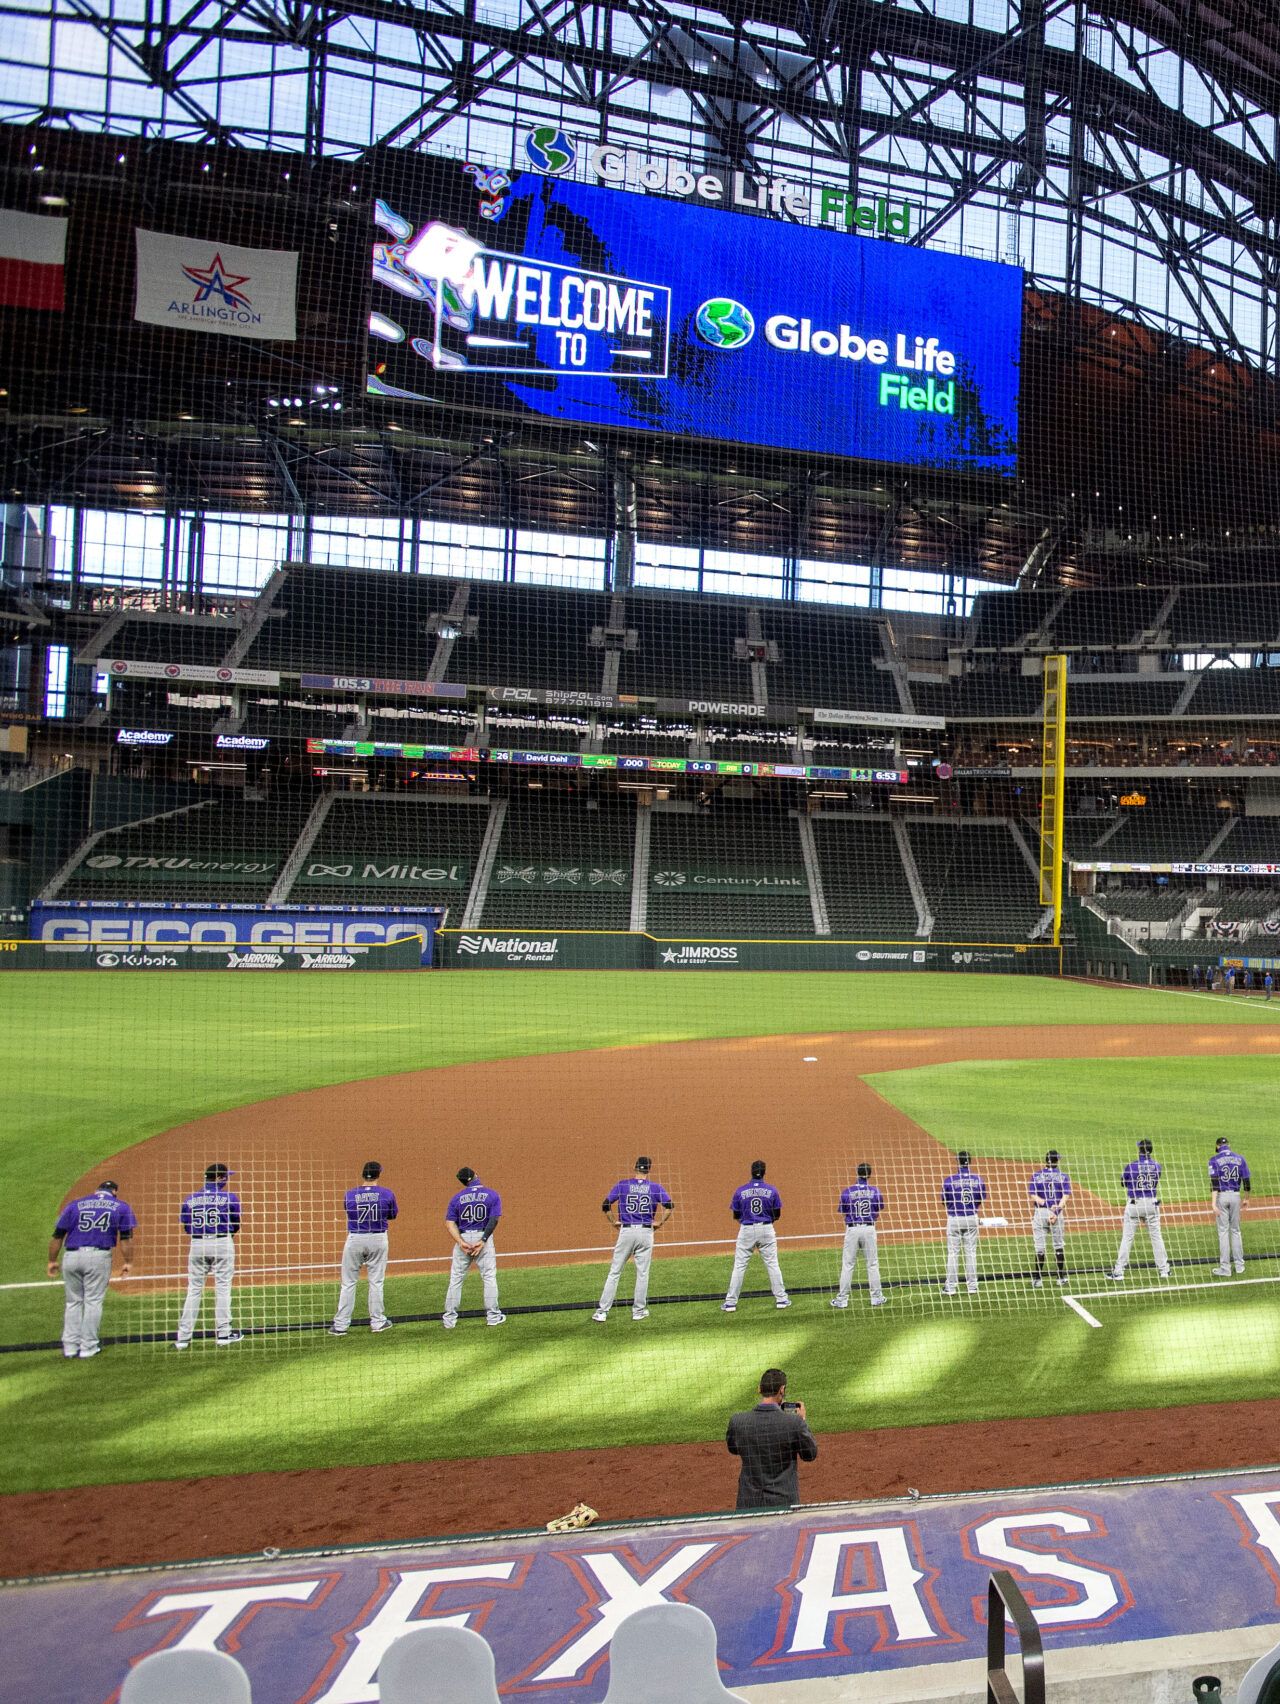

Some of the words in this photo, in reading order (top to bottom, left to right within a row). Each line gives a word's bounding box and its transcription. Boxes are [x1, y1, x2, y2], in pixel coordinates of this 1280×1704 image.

[591, 145, 723, 200] Globe
[735, 171, 810, 217] Life
[821, 190, 910, 237] Field
[473, 257, 655, 337] WELCOME
[168, 300, 261, 324] ARLINGTON
[555, 331, 587, 366] TO
[765, 315, 889, 364] Globe
[896, 333, 955, 375] Life
[879, 372, 955, 414] Field
[332, 677, 370, 690] 105.3
[373, 680, 401, 694] THE
[503, 687, 538, 700] PGL
[546, 690, 613, 702] ShipPGL.com
[688, 701, 766, 717] POWERADE
[117, 729, 173, 743] Academy
[216, 735, 270, 748] Academy
[496, 752, 509, 760] 26
[526, 754, 549, 762] David
[550, 754, 568, 763] Dahl
[597, 758, 613, 766] AVG
[623, 759, 644, 767] .000
[656, 761, 681, 769] TODAY
[743, 765, 751, 773] 0
[876, 772, 897, 781] 6:53
[124, 857, 192, 869] TXU
[361, 864, 459, 881] Mitel
[693, 875, 802, 887] CenturyLink
[41, 919, 237, 953] GEICO
[250, 921, 429, 954] GEICO
[0, 943, 18, 951] 10
[122, 954, 178, 967] Kubota
[241, 954, 277, 964] ARROW
[315, 954, 350, 964] ARROW
[872, 952, 909, 960] SOUTHWEST
[1137, 1173, 1157, 1190] 25
[1220, 1165, 1240, 1182] 34
[625, 1194, 651, 1214] 52
[961, 1187, 972, 1205] 6
[356, 1203, 379, 1224] 71
[460, 1204, 487, 1223] 40
[750, 1197, 763, 1215] 8
[853, 1199, 871, 1217] 12
[78, 1211, 111, 1232] 54
[191, 1208, 220, 1229] 56
[130, 1507, 1128, 1704] TEXAS
